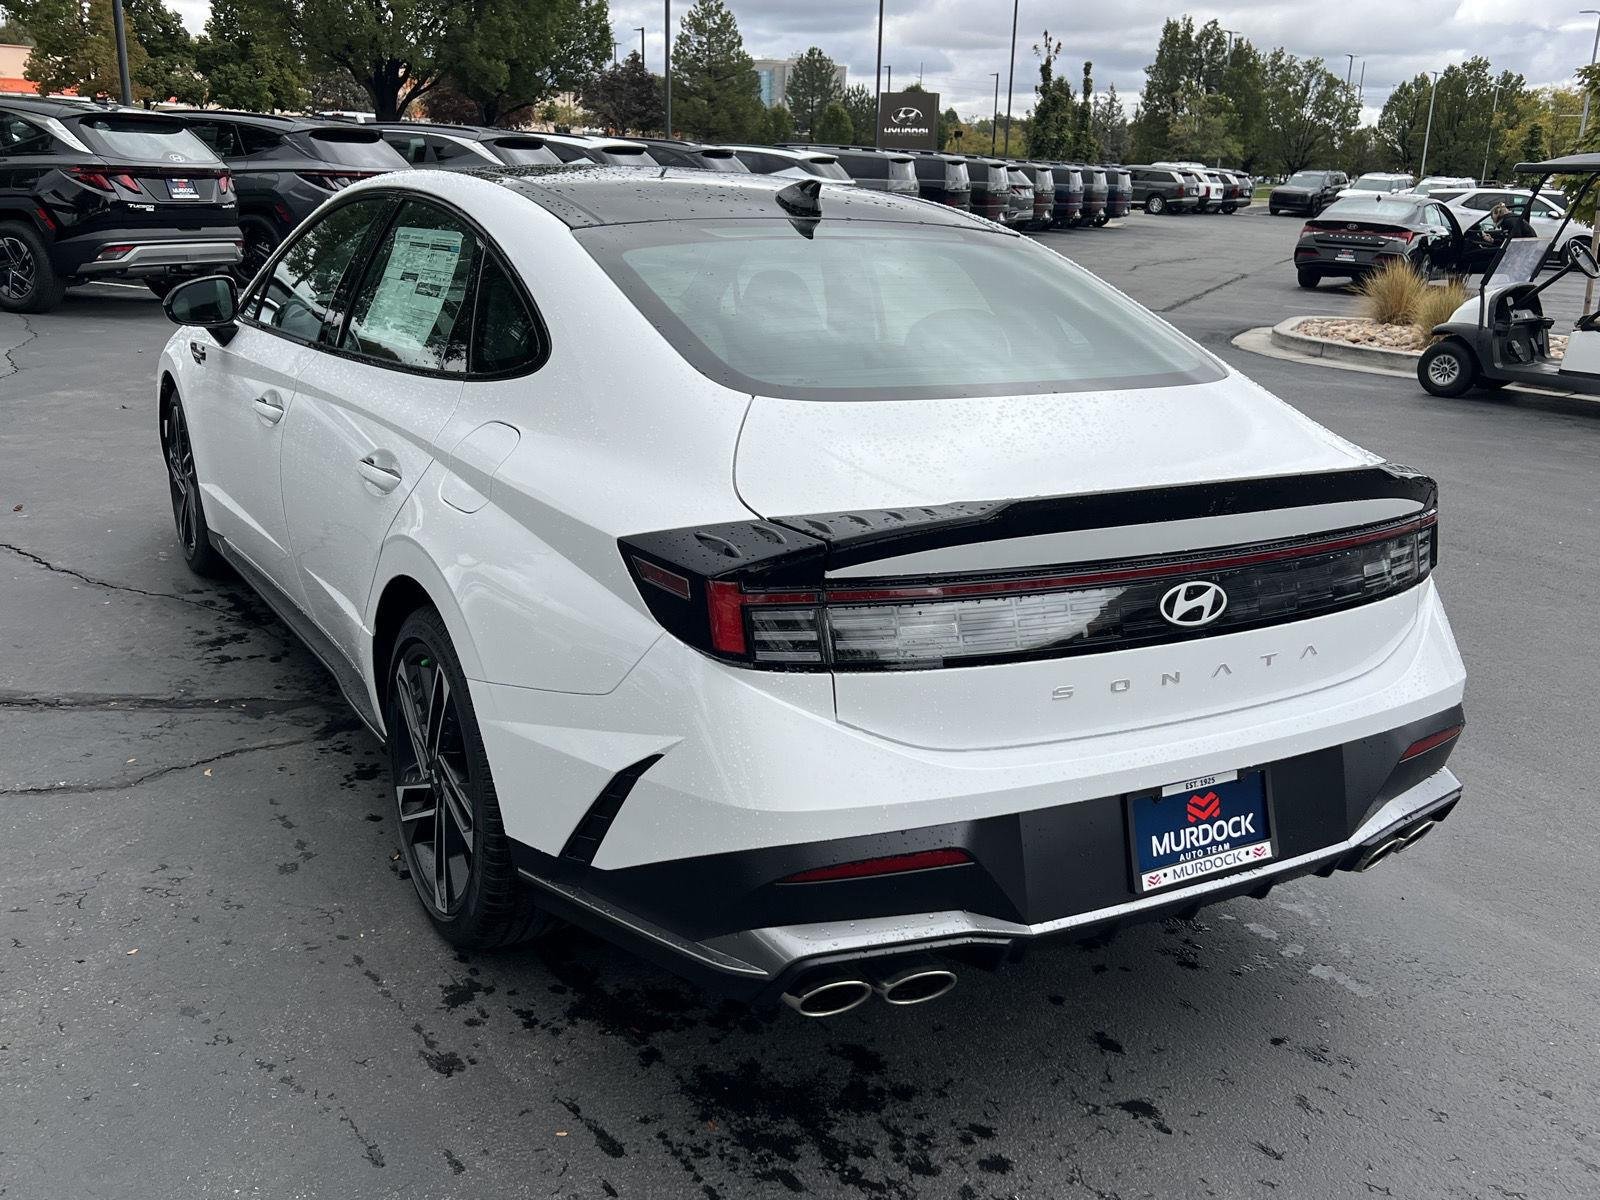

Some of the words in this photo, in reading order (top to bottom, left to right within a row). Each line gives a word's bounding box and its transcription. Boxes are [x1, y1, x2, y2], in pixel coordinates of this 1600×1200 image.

[883, 127, 928, 136] HYUNDAI
[1052, 644, 1318, 700] SONATA
[1185, 779, 1199, 790] EST.
[1200, 776, 1215, 787] 1925
[1151, 812, 1255, 857] MURDOCK
[1179, 849, 1203, 862] AUTO
[1206, 842, 1230, 855] TEAM
[1172, 850, 1243, 880] MURDOCK
